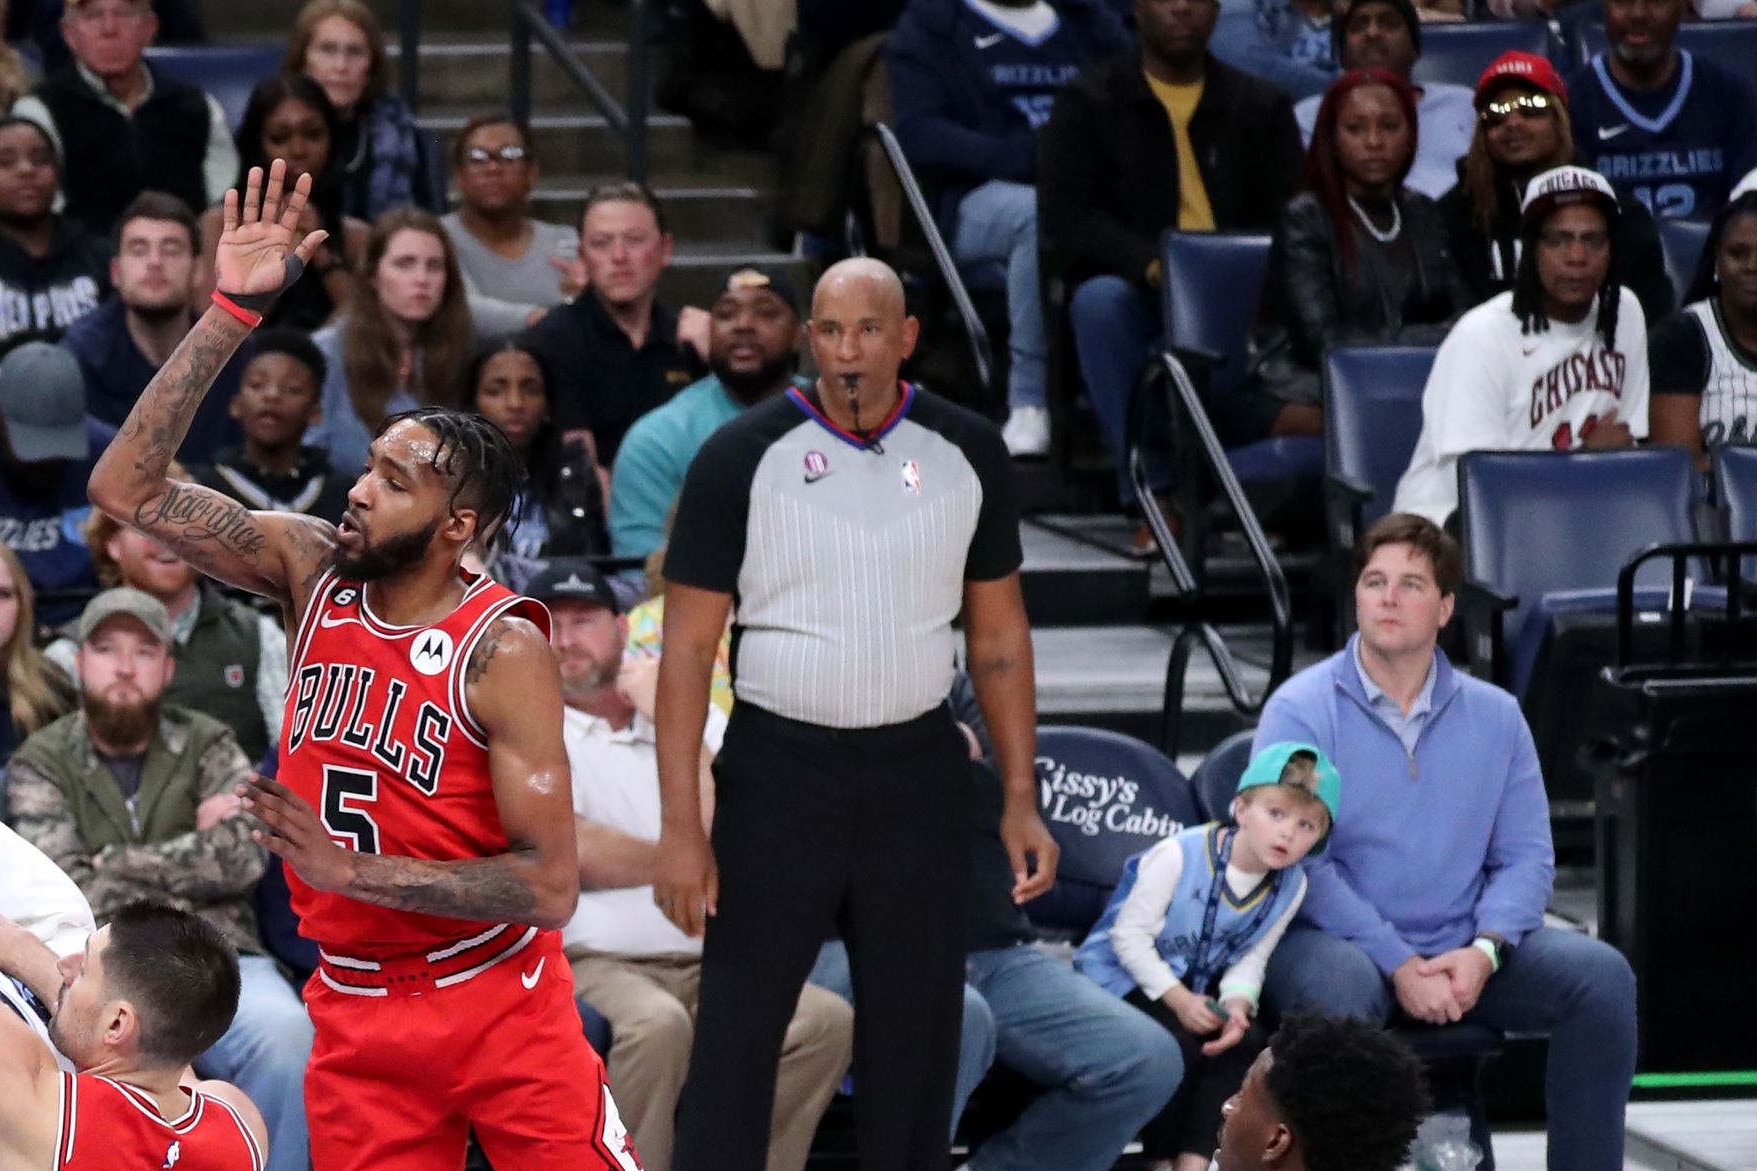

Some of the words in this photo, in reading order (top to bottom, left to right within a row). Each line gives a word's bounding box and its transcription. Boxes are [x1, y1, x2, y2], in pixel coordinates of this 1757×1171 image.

[333, 587, 356, 606] 6
[289, 662, 452, 797] BULLS
[320, 763, 381, 855] 5
[1051, 794, 1104, 836] Log
